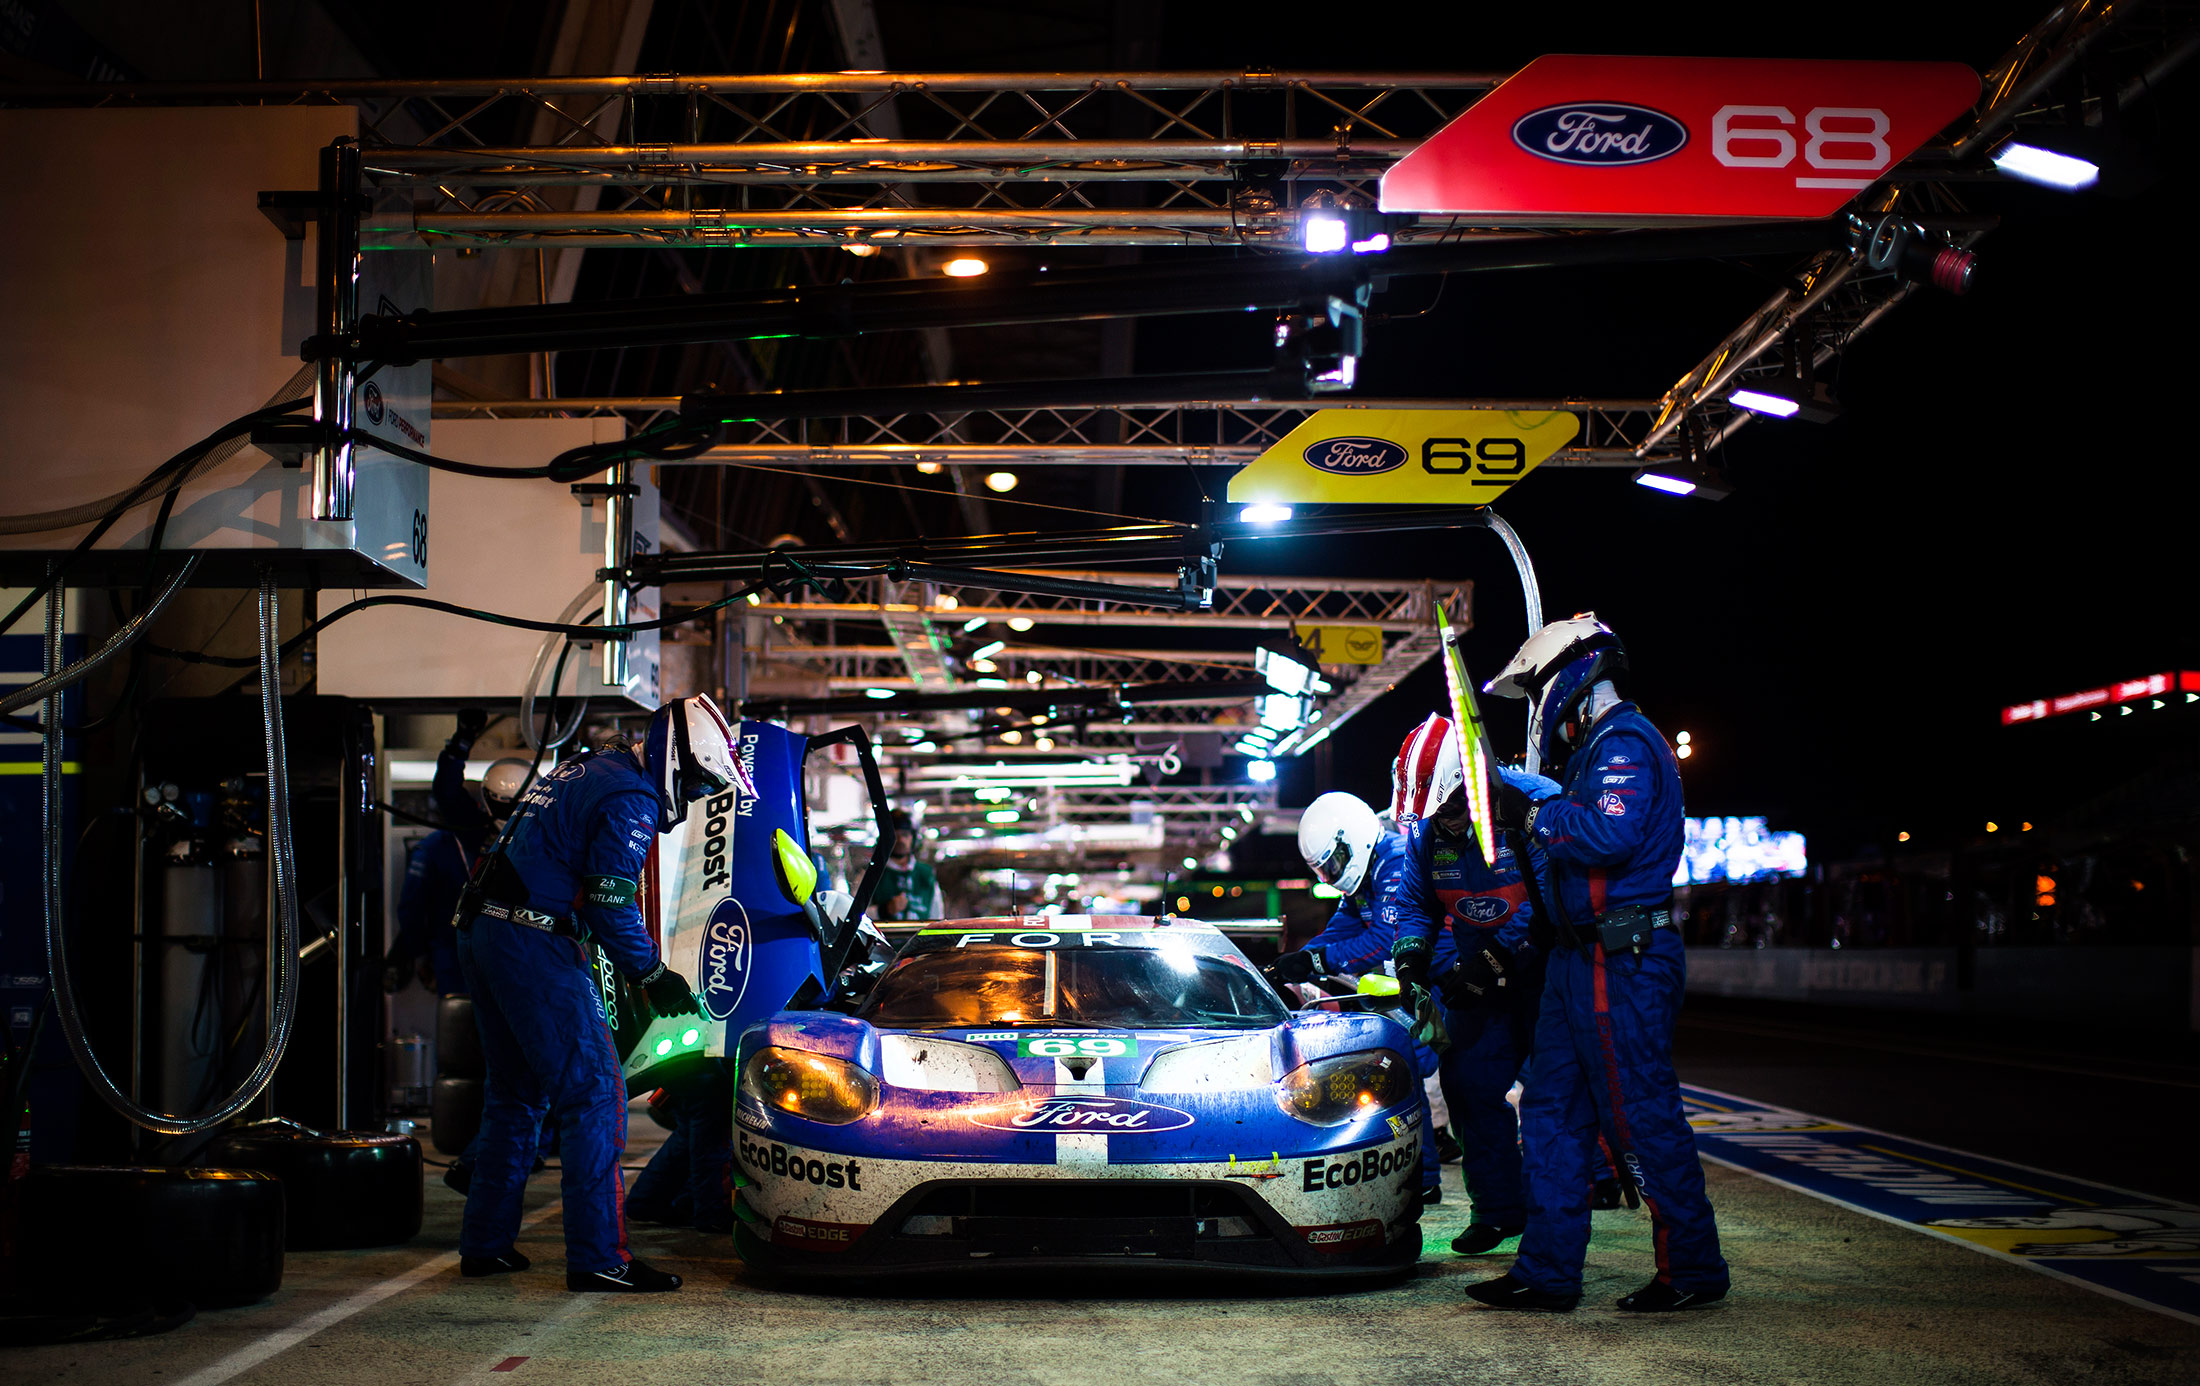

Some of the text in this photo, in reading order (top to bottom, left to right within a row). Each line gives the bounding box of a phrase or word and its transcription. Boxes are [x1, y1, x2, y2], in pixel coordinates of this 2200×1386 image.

[1547, 104, 1891, 171] Ford 68
[1324, 437, 1526, 476] Ford 69
[412, 508, 428, 569] 68
[736, 733, 759, 818] Power by
[702, 790, 734, 892] Boost
[589, 893, 626, 904] PITLANE
[708, 921, 746, 996] Ford
[955, 931, 1121, 949] FOR
[584, 976, 606, 1020] FORD
[969, 1033, 1015, 1041] PRO
[1028, 1038, 1127, 1057] 69
[1011, 1101, 1150, 1129] Ford
[1595, 1014, 1650, 1197] FORD PERFORMANCE
[739, 1130, 862, 1192] EcoBoost
[1302, 1133, 1419, 1193] EcoBoost
[807, 1226, 850, 1242] EDGE
[1343, 1222, 1378, 1242] EDGE
